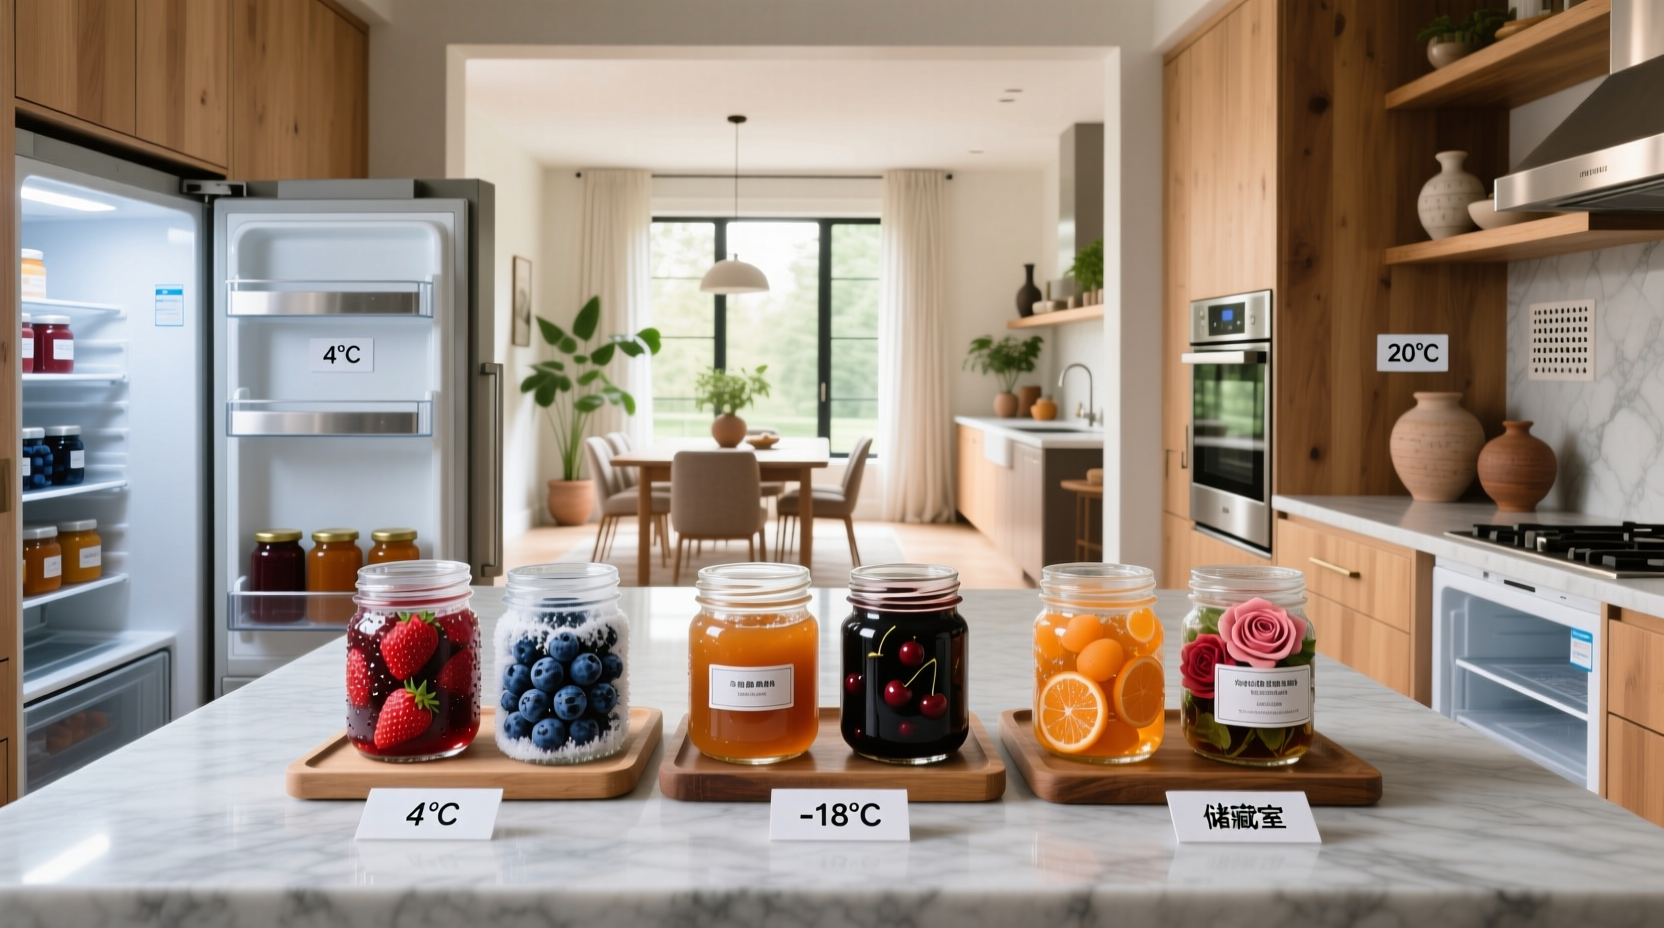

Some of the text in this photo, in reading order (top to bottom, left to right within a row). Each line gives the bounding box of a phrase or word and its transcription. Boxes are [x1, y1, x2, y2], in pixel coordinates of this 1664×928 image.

[323, 344, 361, 365] 4°C
[1388, 342, 1439, 363] 20°C
[405, 801, 460, 827] 4°C
[799, 802, 882, 828] -18°C
[1203, 801, 1287, 831] 储藏室
